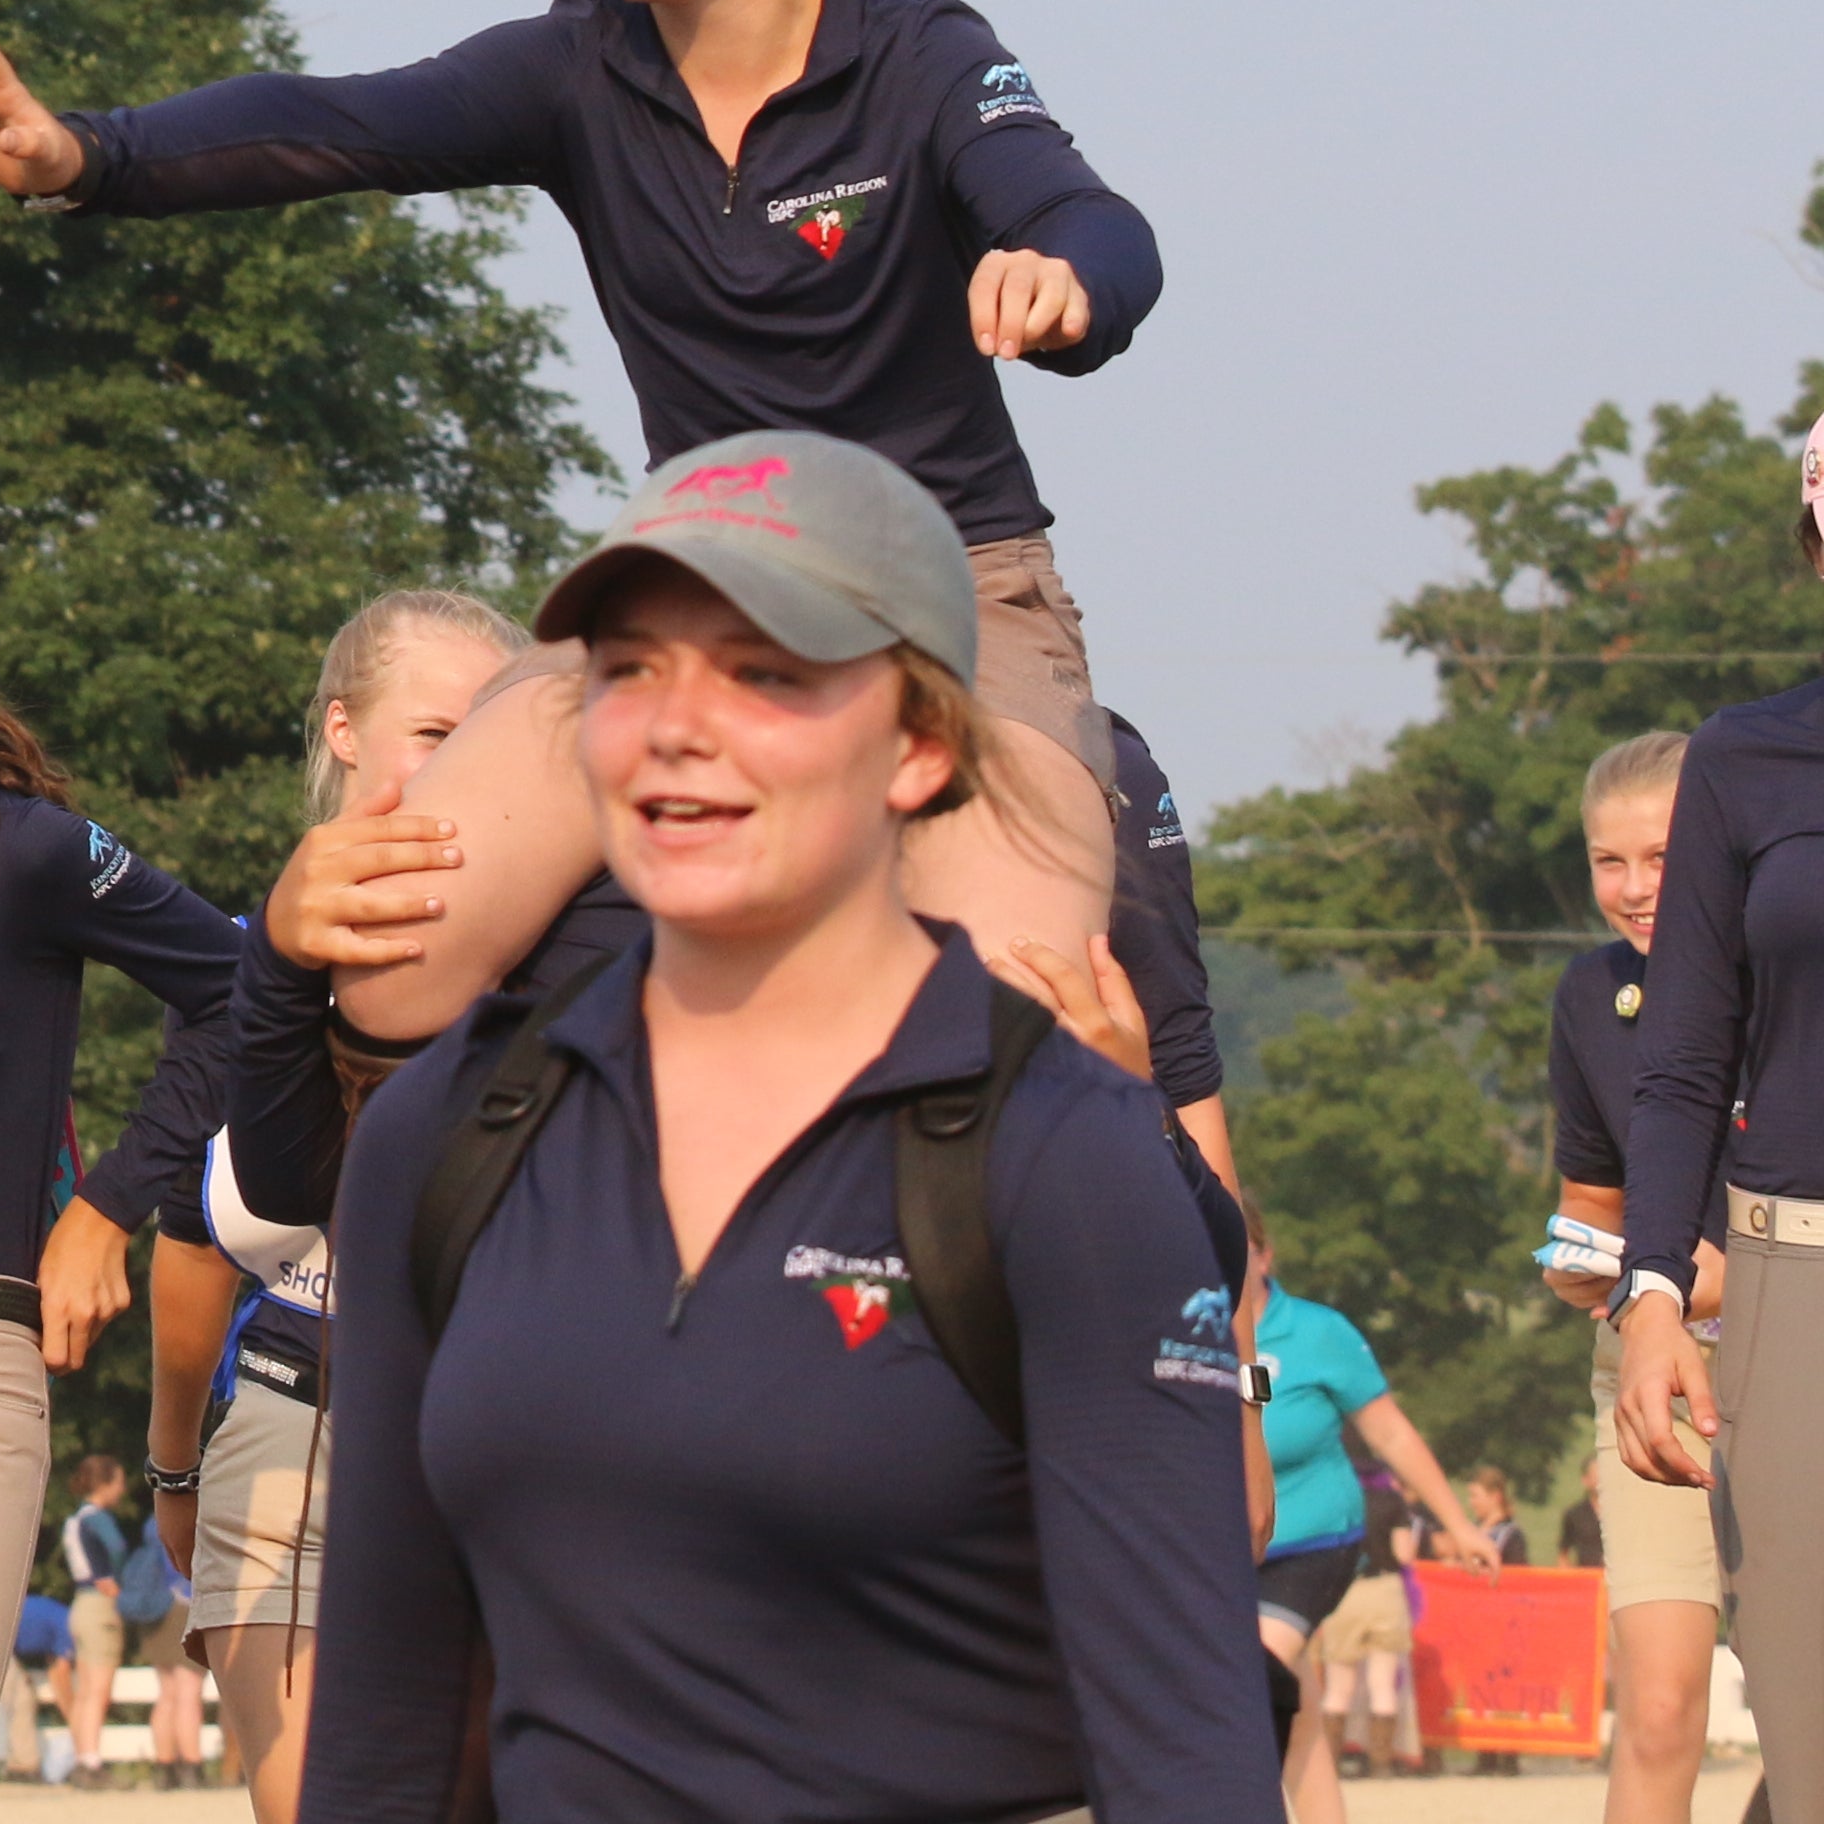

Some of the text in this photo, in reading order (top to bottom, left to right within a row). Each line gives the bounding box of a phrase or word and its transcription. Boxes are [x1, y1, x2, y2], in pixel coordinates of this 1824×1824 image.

[980, 106, 1007, 124] USPC
[766, 176, 888, 213] CAROLINA REGION
[768, 209, 796, 224] USPC
[279, 1260, 337, 1300] SHO
